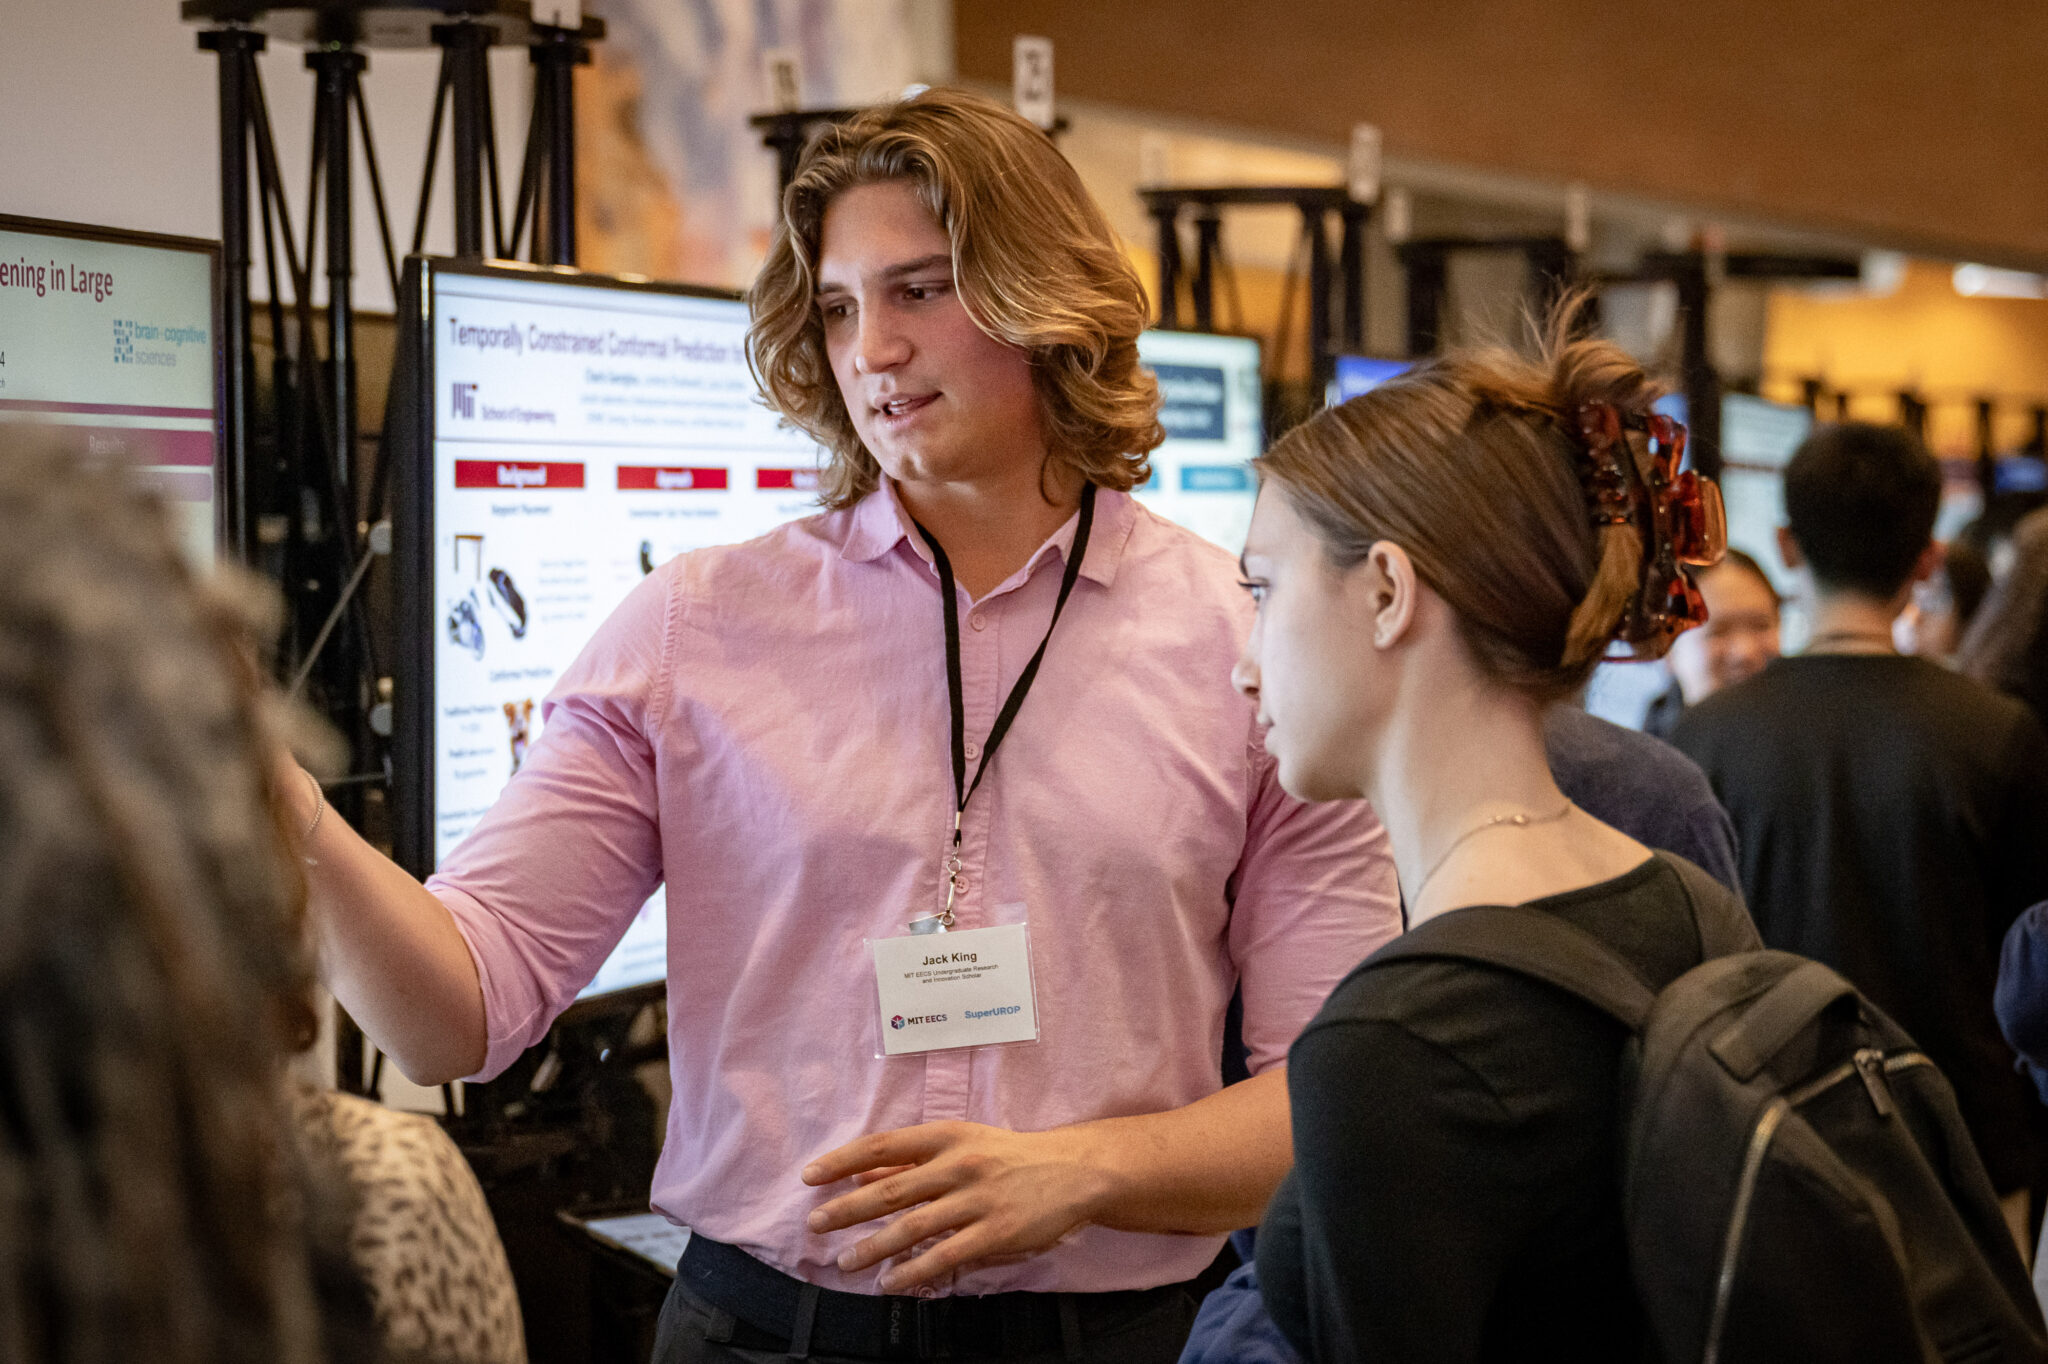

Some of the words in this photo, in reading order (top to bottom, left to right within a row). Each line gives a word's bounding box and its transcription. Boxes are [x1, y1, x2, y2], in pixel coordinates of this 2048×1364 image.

[50, 259, 65, 292] in
[70, 263, 113, 303] Large
[450, 317, 523, 357] Temporally
[530, 323, 602, 355] Constrained
[922, 954, 949, 966] Jack
[951, 952, 978, 963] King
[915, 970, 932, 978] EECS
[932, 966, 972, 976] Undergraduate
[972, 964, 999, 972] Research
[933, 975, 960, 983] Innovation
[907, 1015, 924, 1025] MIT
[925, 1014, 948, 1024] EECS
[964, 1005, 1021, 1020] SuperUROP
[889, 1297, 901, 1345] RCADE
